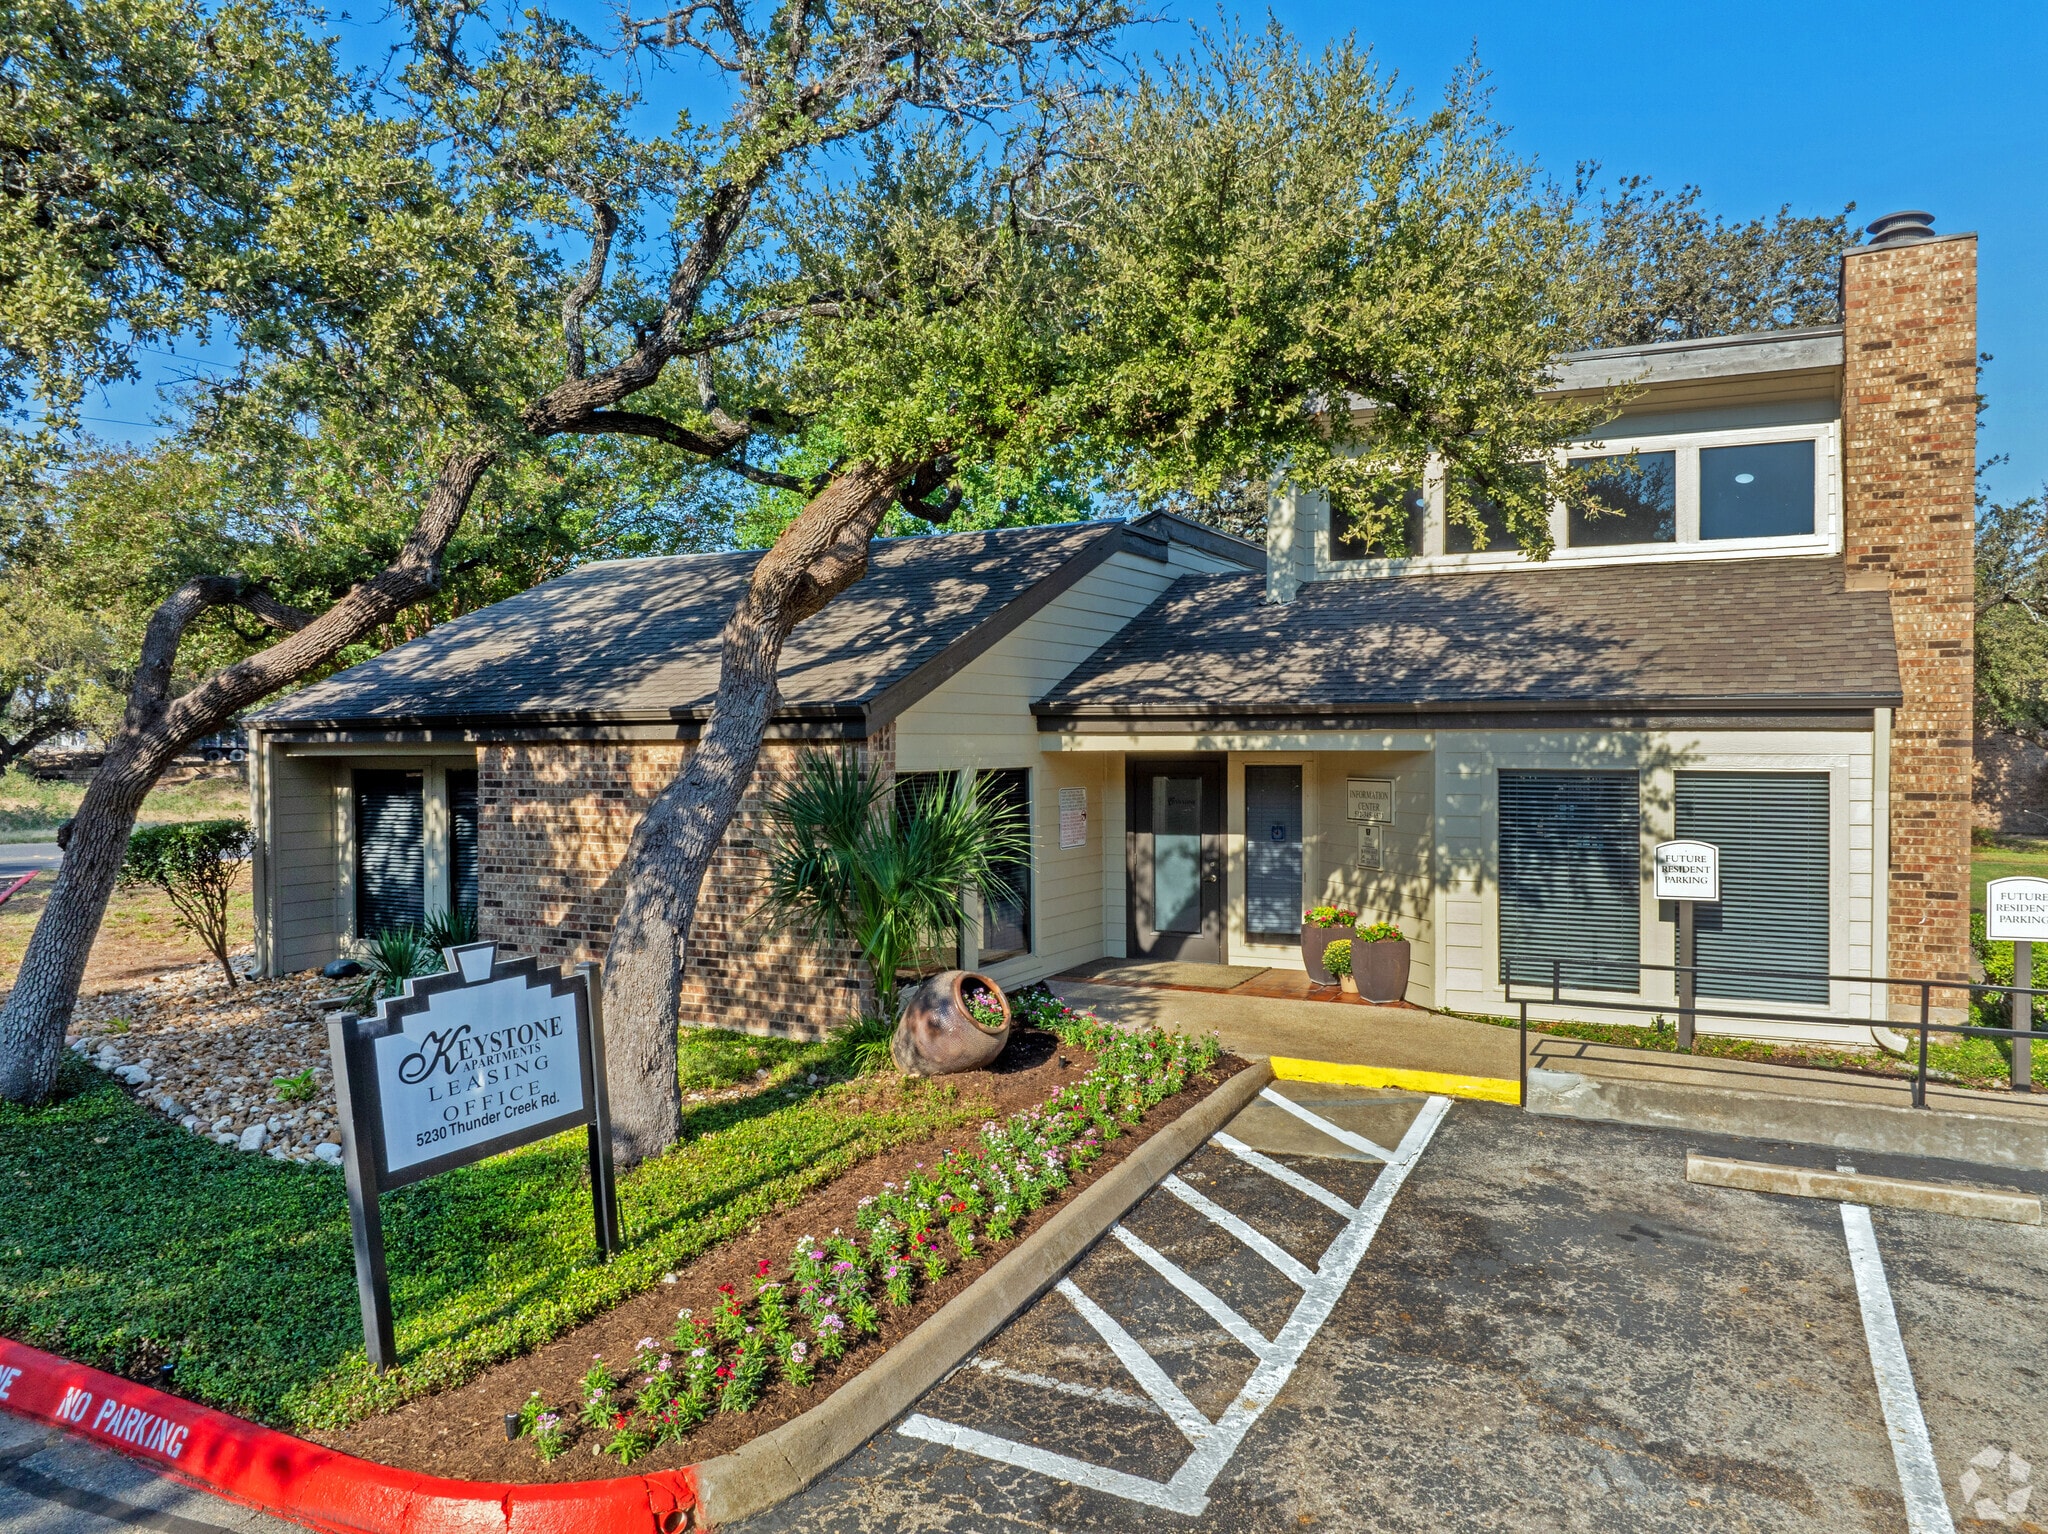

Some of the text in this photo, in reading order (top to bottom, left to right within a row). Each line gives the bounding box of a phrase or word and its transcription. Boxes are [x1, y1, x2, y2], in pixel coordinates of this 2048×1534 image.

[1349, 790, 1389, 800] INFORMATION
[1357, 802, 1380, 811] CENTER
[1665, 854, 1707, 863] FUTURE
[1661, 865, 1711, 874] RESIDENT
[1664, 876, 1708, 884] PARKING
[2000, 892, 2048, 901] FUTURE
[1996, 903, 2048, 912] RESIDEN
[398, 1016, 563, 1084] KEYSTONE
[463, 1042, 541, 1073] APARTMENTS
[428, 1055, 549, 1102] LEASING
[443, 1080, 541, 1122] OFFICE
[416, 1092, 560, 1147] 5230 Thunder Creek Rd.
[55, 1386, 189, 1459] NO PARKING
